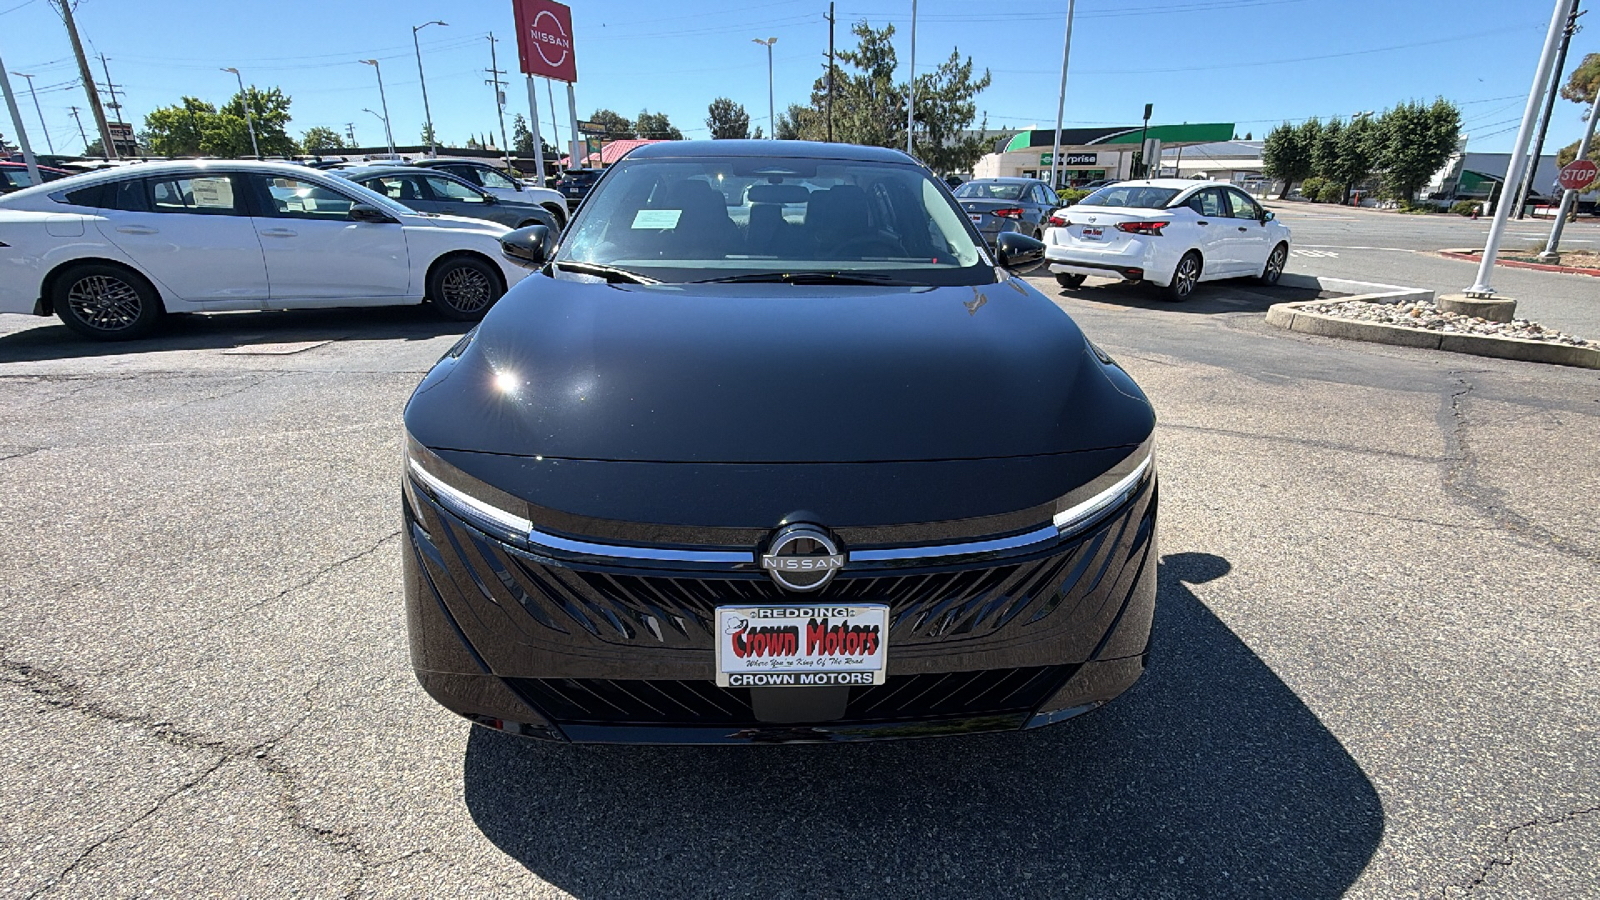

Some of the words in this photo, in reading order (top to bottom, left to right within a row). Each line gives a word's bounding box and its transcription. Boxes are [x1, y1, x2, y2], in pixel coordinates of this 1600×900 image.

[531, 30, 569, 48] NISSAN
[1561, 169, 1596, 181] STOP
[764, 557, 843, 569] NISSAN
[759, 609, 848, 618] REDDING
[732, 621, 799, 658] Crown
[806, 619, 879, 656] Motors
[796, 659, 814, 667] King
[816, 658, 826, 667] Of
[828, 658, 842, 666] The
[729, 674, 795, 686] CROWN
[799, 672, 873, 685] MOTORS
